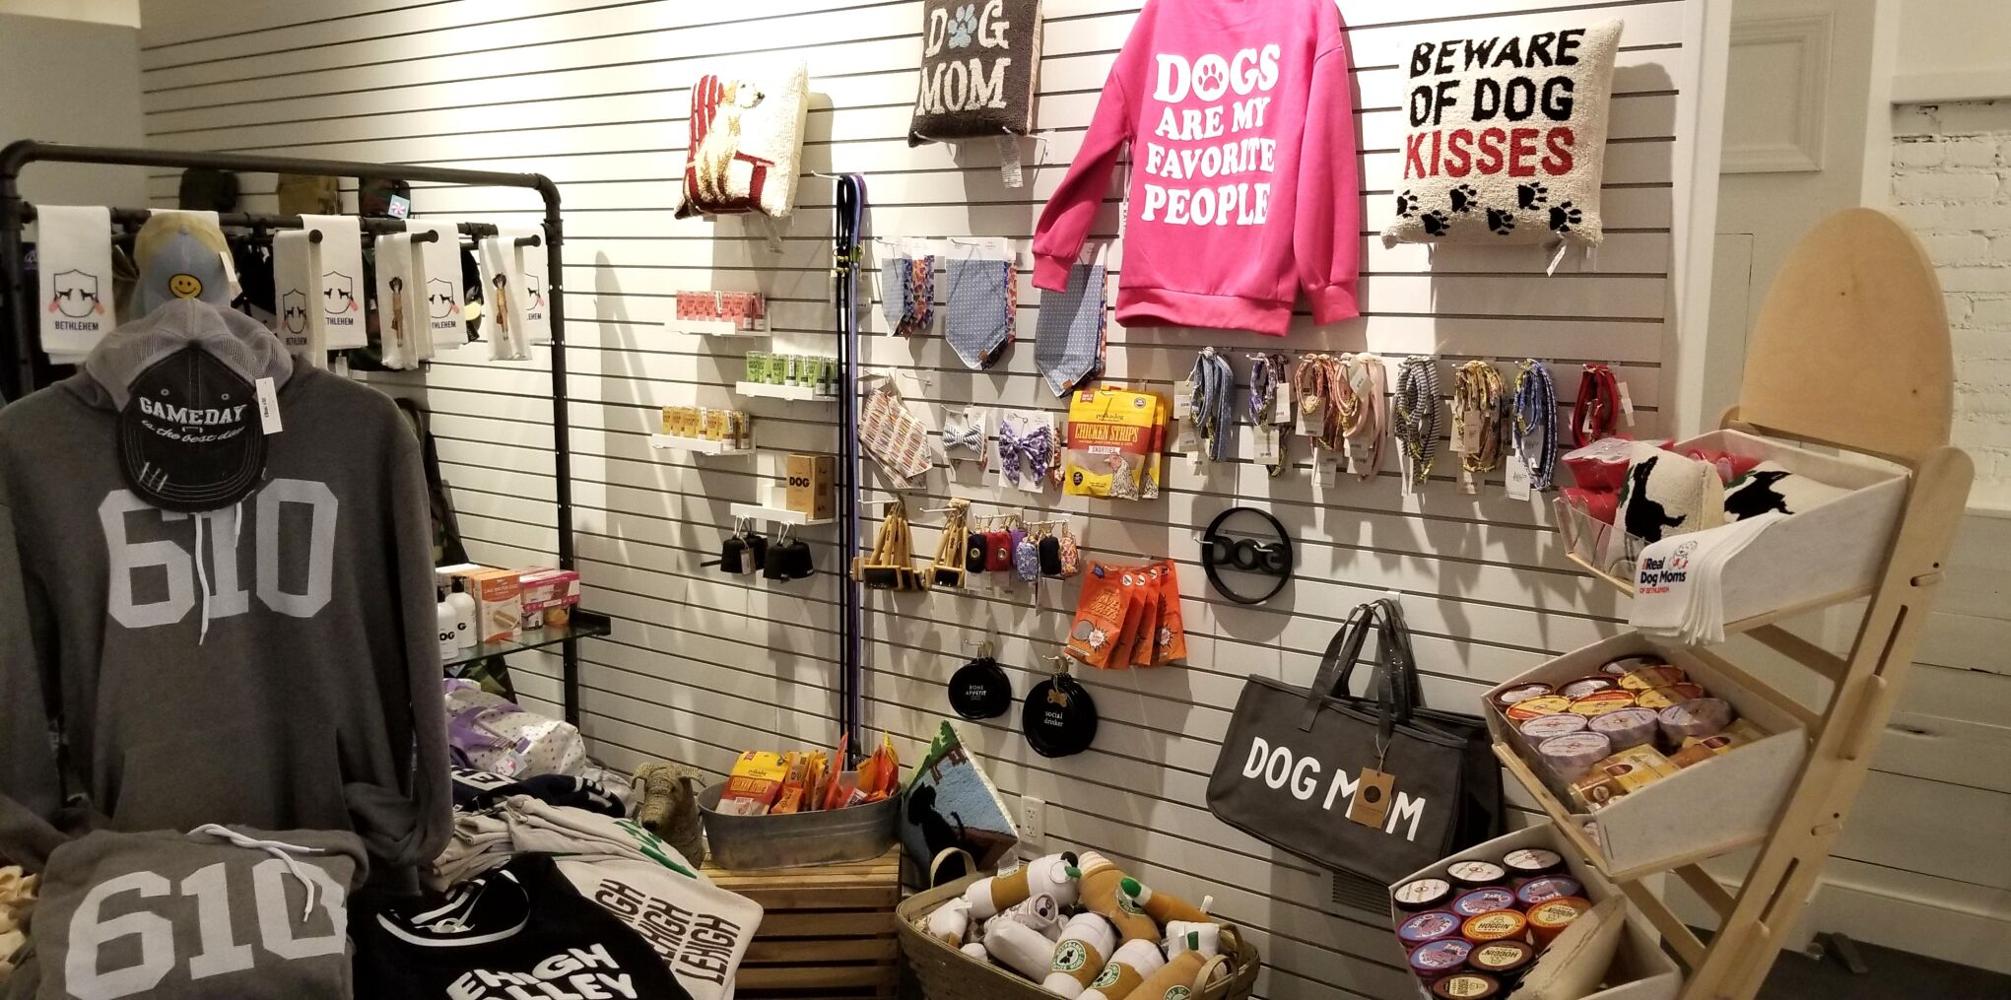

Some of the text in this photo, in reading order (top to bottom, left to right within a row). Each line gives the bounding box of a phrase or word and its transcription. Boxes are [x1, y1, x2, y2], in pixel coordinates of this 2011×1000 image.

[1153, 43, 1281, 104] DOGS
[1410, 28, 1586, 79] BEWARE
[915, 57, 1012, 117] MOM
[1410, 76, 1575, 128] OF DOG
[1154, 97, 1271, 142] ARE MY
[1145, 138, 1276, 180] FAVORITE
[1404, 127, 1576, 179] KISSES
[1140, 182, 1271, 226] PEOPLE
[55, 320, 100, 331] BETHLEHEM
[326, 317, 354, 326] THLEHEM
[431, 321, 457, 329] THLEHEM
[139, 396, 248, 426] GAMEDAY
[156, 426, 181, 440] the
[182, 432, 217, 443] best
[1074, 423, 1140, 443] CHICKEN STRIPS
[789, 476, 810, 488] DOG
[99, 478, 339, 628] 610
[1204, 533, 1290, 575] DOG
[1647, 556, 1666, 571] Real
[1640, 570, 1687, 587] Dog Moms
[439, 632, 455, 641] OG
[1043, 718, 1064, 728] drinker
[1045, 711, 1063, 719] social
[1242, 736, 1427, 842] DOG MM
[65, 858, 348, 1000] 610
[675, 913, 742, 986] LEHIGH
[446, 943, 620, 1000] EHIGH
